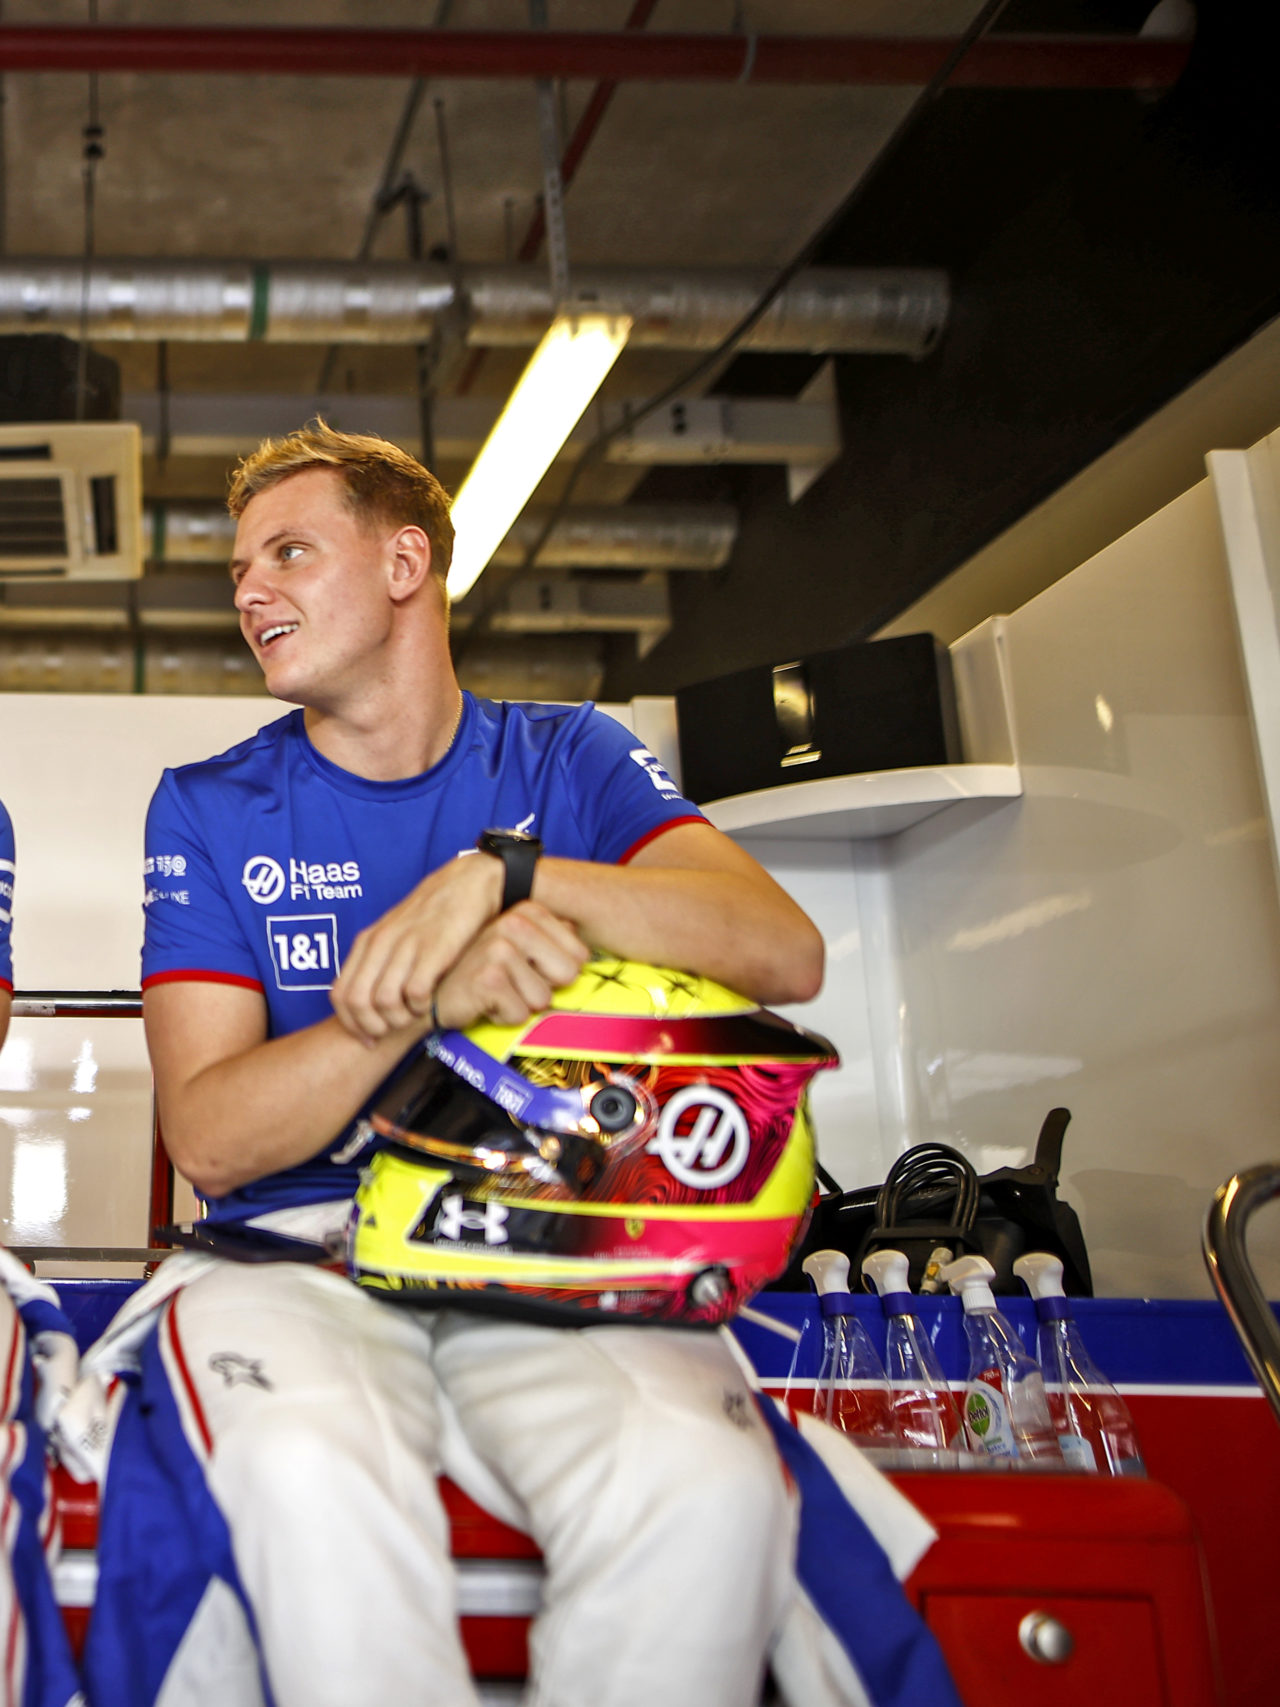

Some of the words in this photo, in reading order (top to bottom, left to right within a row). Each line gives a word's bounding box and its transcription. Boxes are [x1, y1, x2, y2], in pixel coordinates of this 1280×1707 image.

[289, 858, 360, 885] Haas
[311, 883, 363, 900] Team
[274, 932, 330, 970] 1&1
[453, 1056, 486, 1092] Inc.
